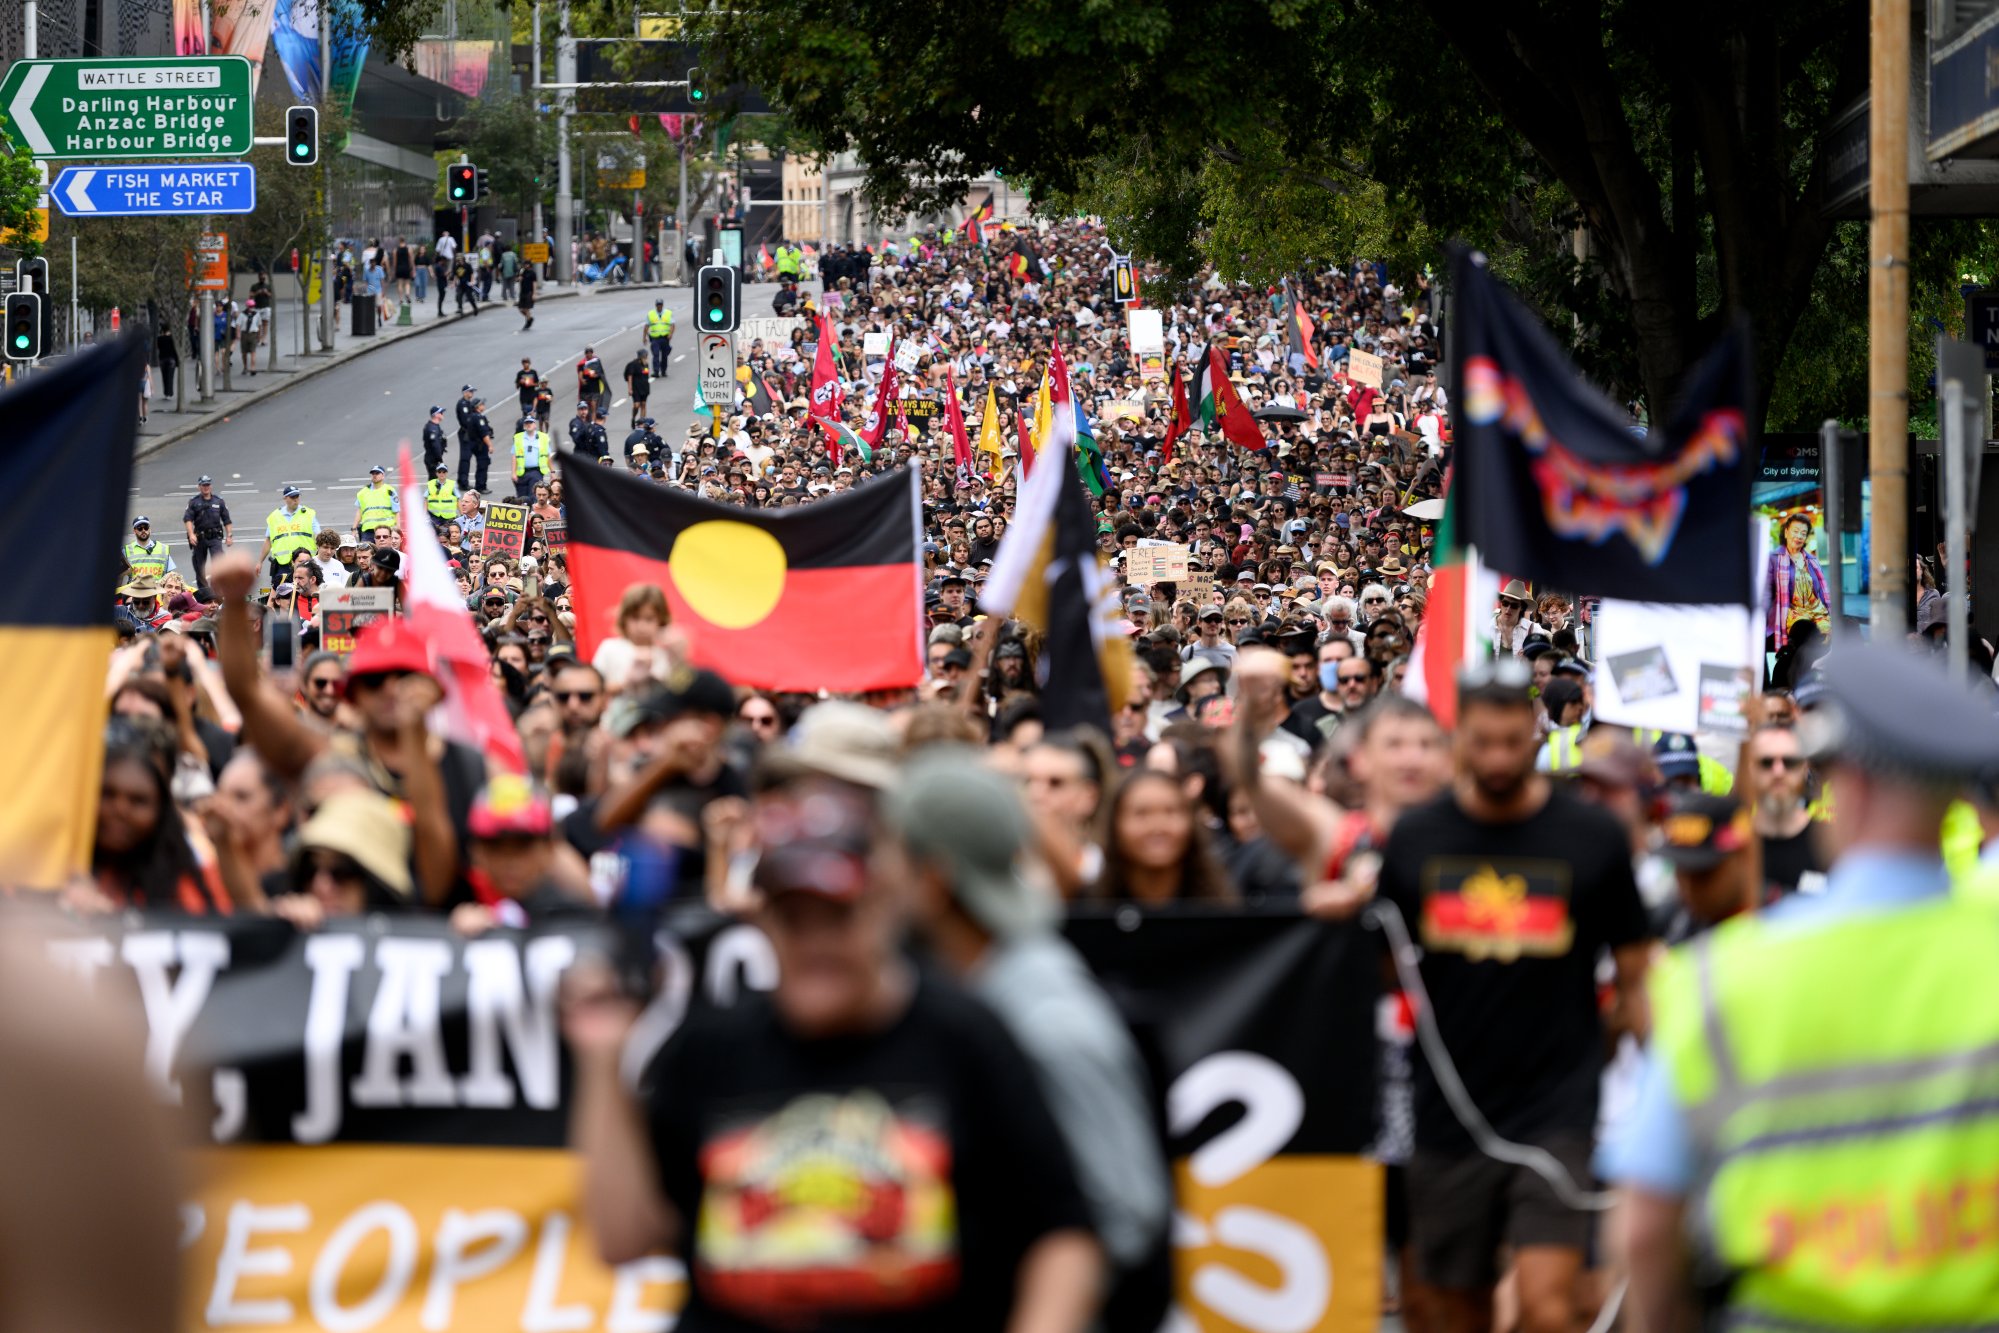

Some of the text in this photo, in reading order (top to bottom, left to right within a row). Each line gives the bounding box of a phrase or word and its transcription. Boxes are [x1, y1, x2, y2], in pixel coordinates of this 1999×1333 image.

[84, 72, 215, 85] WATTLE STREET
[63, 96, 237, 116] Darling Harbour
[77, 114, 225, 132] Anzac Bridge
[67, 133, 232, 152] Harbour Bridge
[107, 172, 240, 188] FISH MARKET
[124, 191, 224, 207] THE STAR
[707, 367, 725, 378] NO
[703, 380, 730, 388] RIGHT
[704, 391, 729, 399] TURN
[1763, 467, 1819, 477] City of Sydney
[490, 506, 522, 522] NO
[486, 521, 523, 531] JUSTICE
[488, 531, 518, 546] NO
[547, 531, 568, 541] STO
[483, 545, 519, 555] PEACE
[550, 547, 568, 555] BLA
[1131, 547, 1157, 559] FREE
[133, 566, 162, 575] POLICE
[327, 613, 353, 631] ST
[327, 637, 357, 651] BLA
[293, 932, 575, 1143] JAN
[180, 1202, 690, 1333] EOPLE
